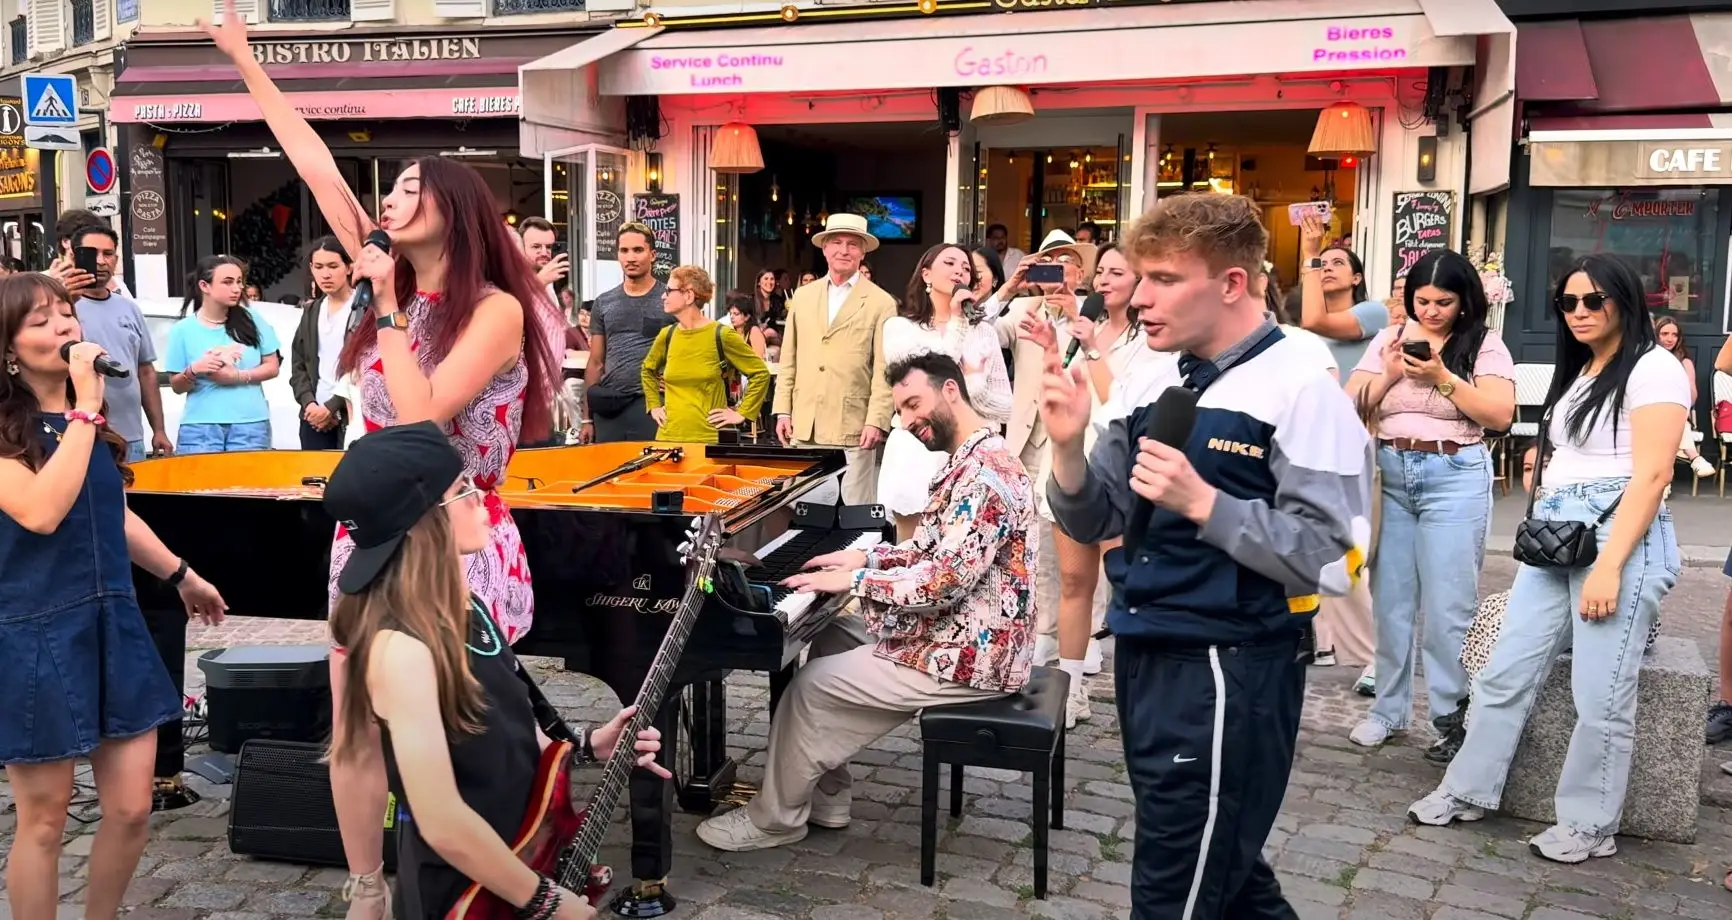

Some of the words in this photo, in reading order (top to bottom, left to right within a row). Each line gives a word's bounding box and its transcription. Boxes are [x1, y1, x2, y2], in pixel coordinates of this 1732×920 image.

[1326, 26, 1393, 41] Bieres
[250, 43, 351, 64] BISTRO
[363, 38, 481, 61] ITALIEN
[1312, 46, 1406, 62] Pression
[651, 56, 712, 70] Service
[716, 54, 783, 67] Continu
[954, 46, 1047, 76] Gaston
[690, 73, 743, 87] Lunch
[134, 104, 165, 120] PASTA
[173, 103, 202, 119] PIZZA
[1649, 149, 1721, 172] CAFE
[136, 192, 160, 203] PIZZA
[136, 208, 161, 219] PASTA
[1395, 212, 1446, 244] BURGERS
[1207, 437, 1265, 459] NIKE
[586, 592, 648, 613] SHIGERU
[647, 597, 680, 614] KAW
